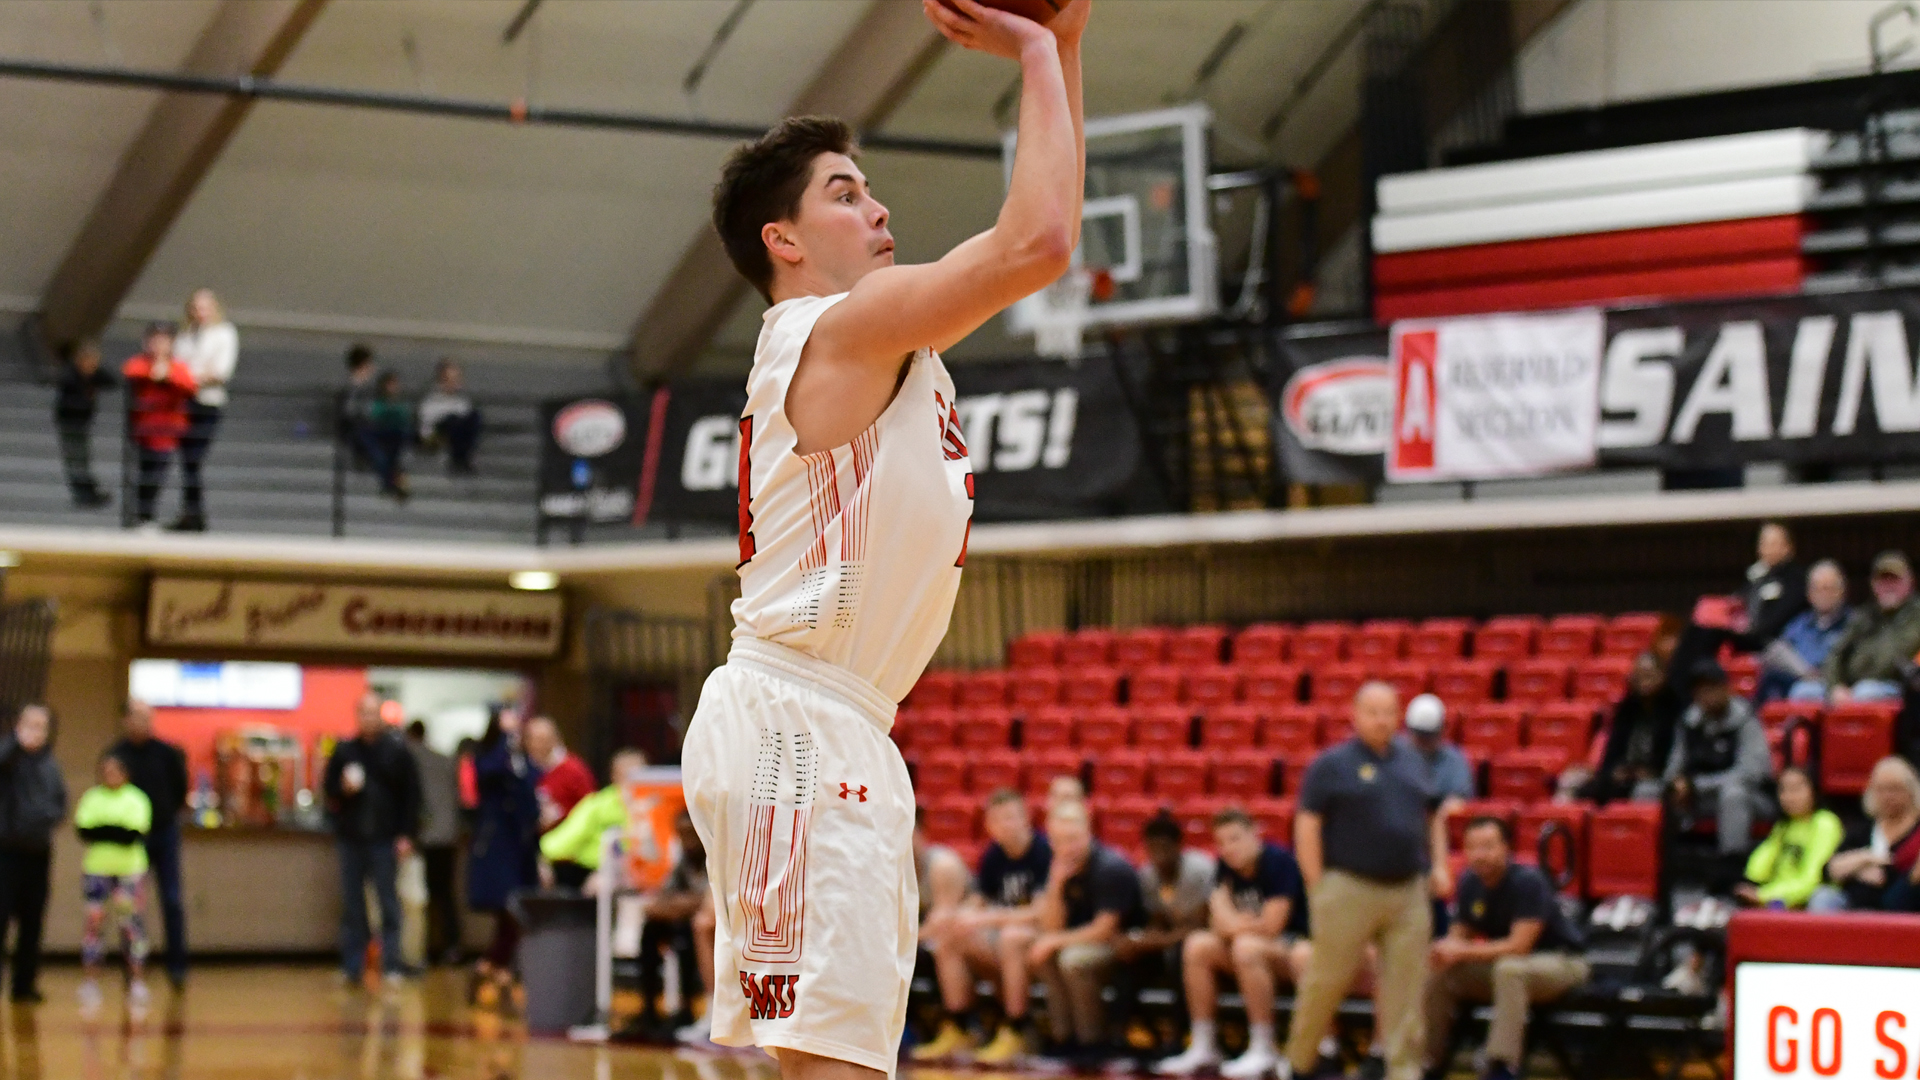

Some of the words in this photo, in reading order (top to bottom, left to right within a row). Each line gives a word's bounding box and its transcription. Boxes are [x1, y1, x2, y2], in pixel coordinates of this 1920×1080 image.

[681, 415, 739, 491] G
[955, 387, 1079, 474] TS!
[1767, 1005, 1843, 1076] GO
[1875, 1010, 1920, 1080] S
